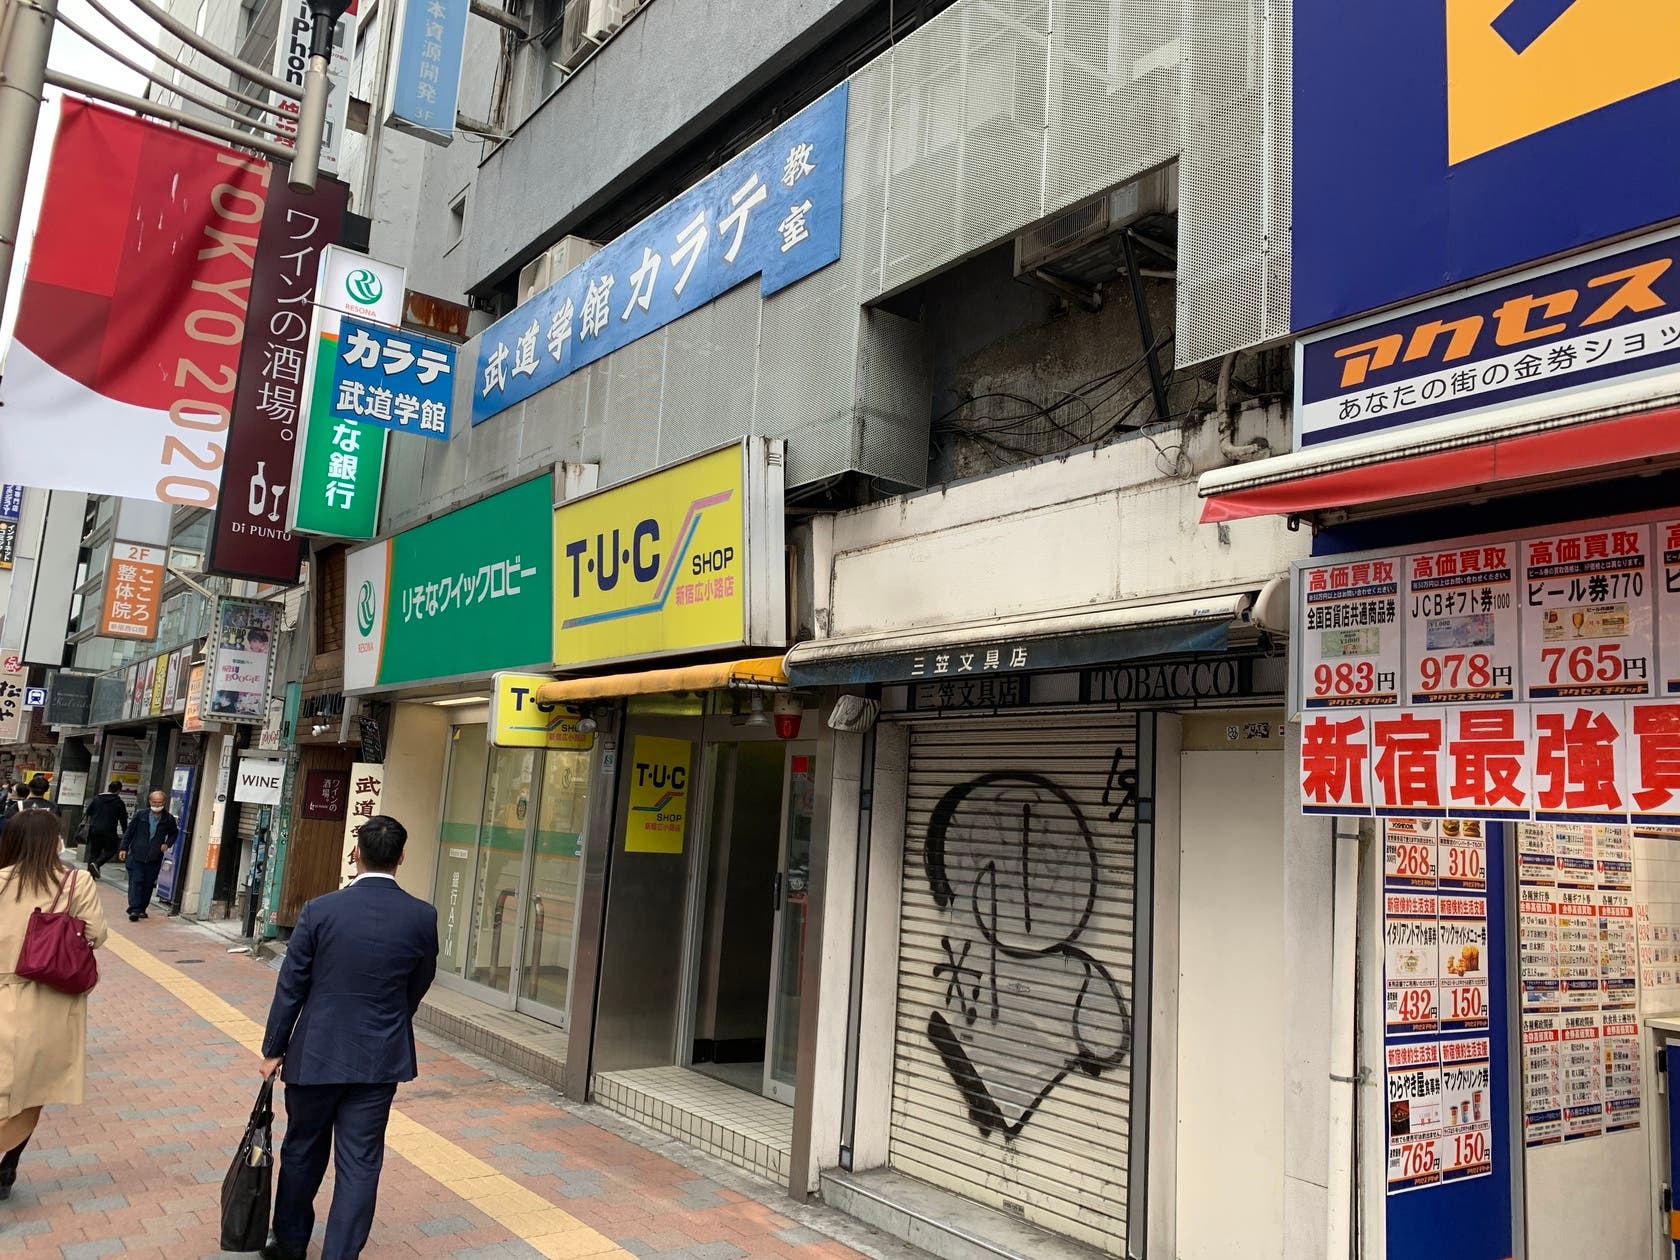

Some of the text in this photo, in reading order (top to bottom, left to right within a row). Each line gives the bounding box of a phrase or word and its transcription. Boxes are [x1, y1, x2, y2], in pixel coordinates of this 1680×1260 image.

[414, 106, 435, 121] 3F
[256, 208, 320, 442] ワインの酒場。
[345, 303, 377, 318] RESONA
[1333, 257, 1673, 389] アクセス
[342, 327, 451, 385] カラテ
[336, 378, 447, 434] 武道学館
[325, 419, 362, 510] な銀行
[232, 522, 246, 535] Di
[128, 546, 151, 560] 2F
[692, 547, 734, 576] SHOP
[1413, 547, 1507, 580] 高価買取
[1529, 531, 1640, 567] 高価買取
[111, 563, 155, 622] こころ 整体院
[401, 554, 538, 624] りそなクイックロビー
[674, 575, 735, 607] 新宿広小路店
[1309, 561, 1394, 592] 高価買取
[1307, 598, 1396, 631] 全国百貨店共通商品券
[911, 645, 1028, 676] 三笠文具店
[918, 679, 1019, 708] 三笠文具店
[1093, 659, 1236, 701] TOBACCO
[1557, 684, 1648, 697] アクセスチケット
[1301, 703, 1680, 812] 新宿最強買
[241, 774, 280, 789] WINE
[656, 813, 682, 822] SHOP
